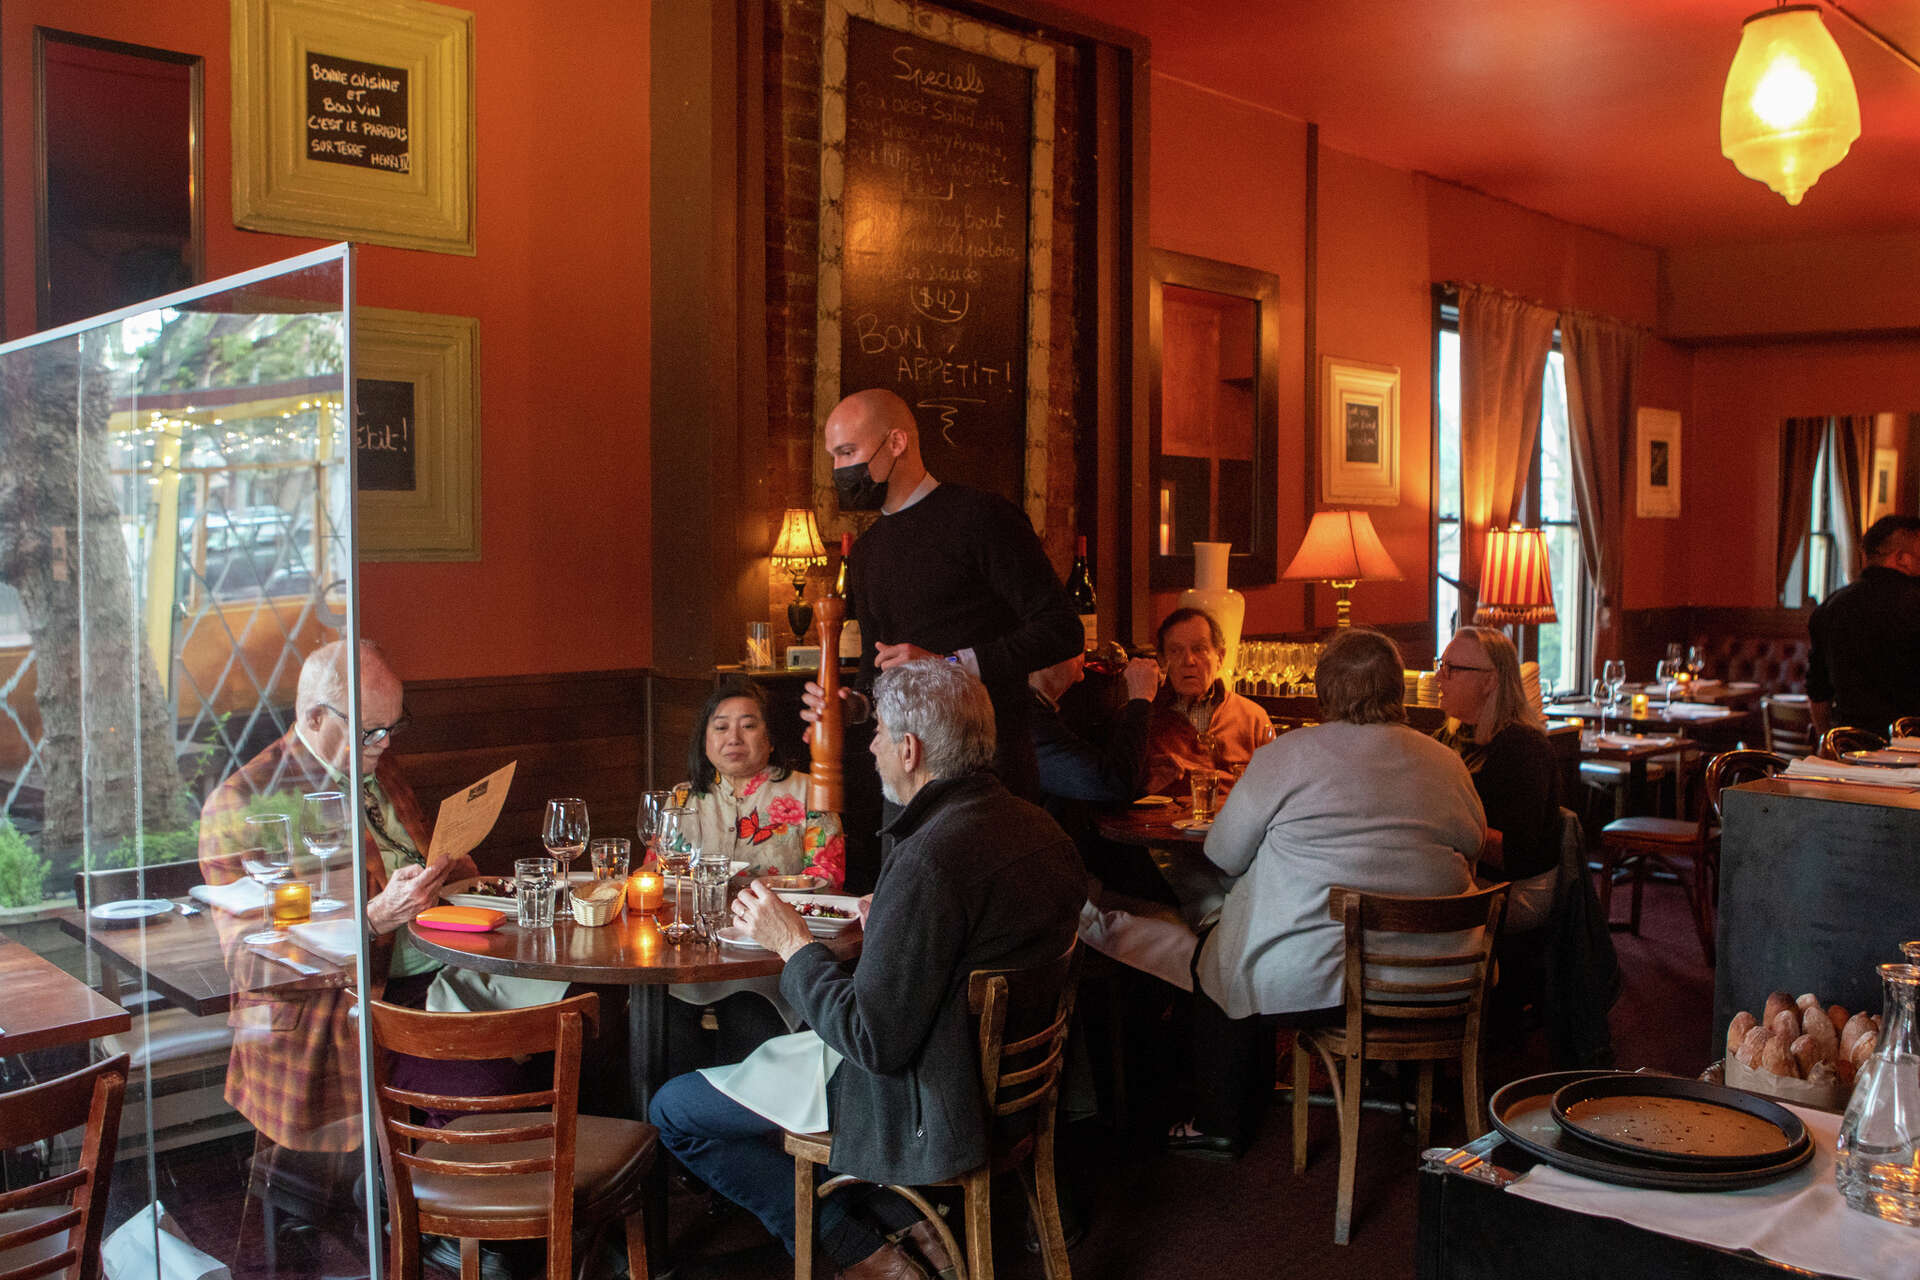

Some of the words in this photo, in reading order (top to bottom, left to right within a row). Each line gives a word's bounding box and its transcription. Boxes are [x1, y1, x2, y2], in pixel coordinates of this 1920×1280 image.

[311, 63, 348, 85] BONNE
[892, 46, 985, 93] Specials
[308, 115, 343, 131] C'EST
[346, 120, 358, 133] LE
[361, 121, 408, 141] PARADIS
[932, 100, 976, 128] Salad
[311, 138, 335, 153] SUR
[334, 140, 367, 157] TERRE
[919, 286, 962, 315] $42
[855, 313, 923, 354] BON
